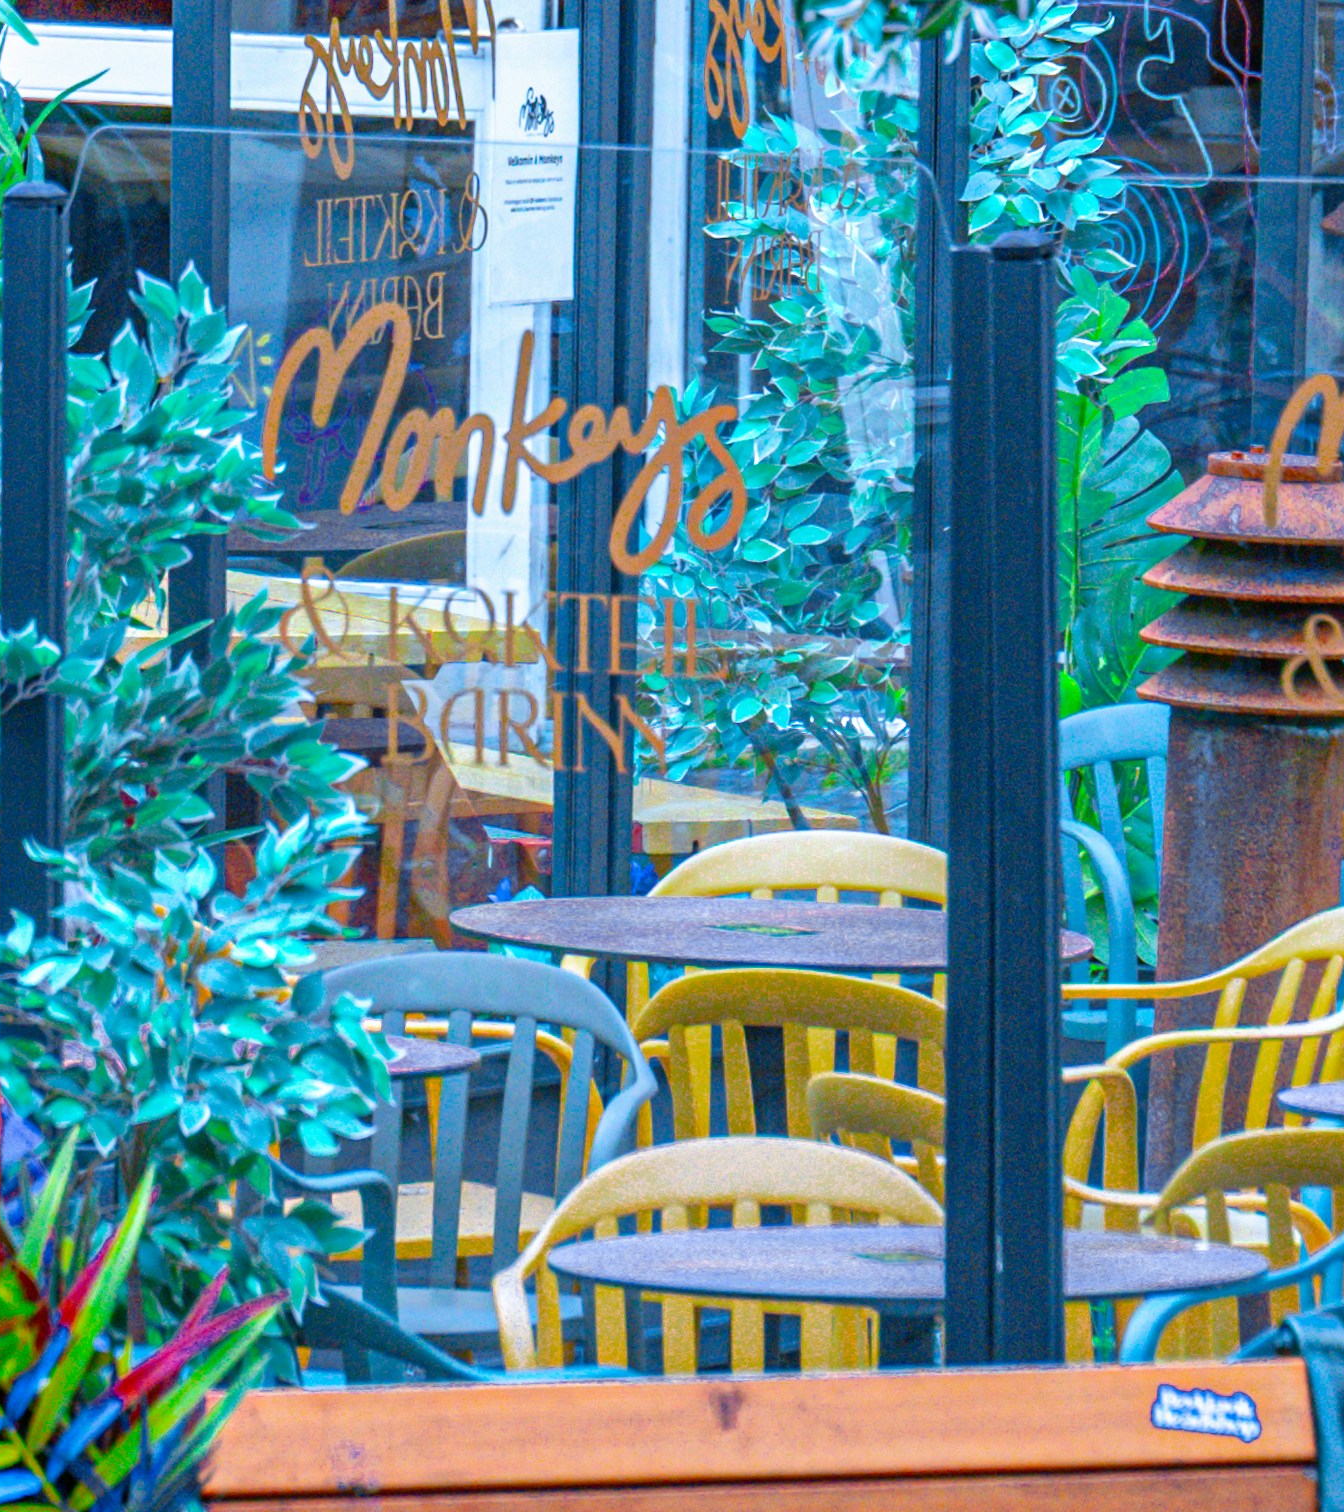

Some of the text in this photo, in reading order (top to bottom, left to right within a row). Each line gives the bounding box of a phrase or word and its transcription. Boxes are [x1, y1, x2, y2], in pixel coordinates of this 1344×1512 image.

[261, 301, 748, 576] Monkeys
[279, 561, 730, 680] & KOKTEIL
